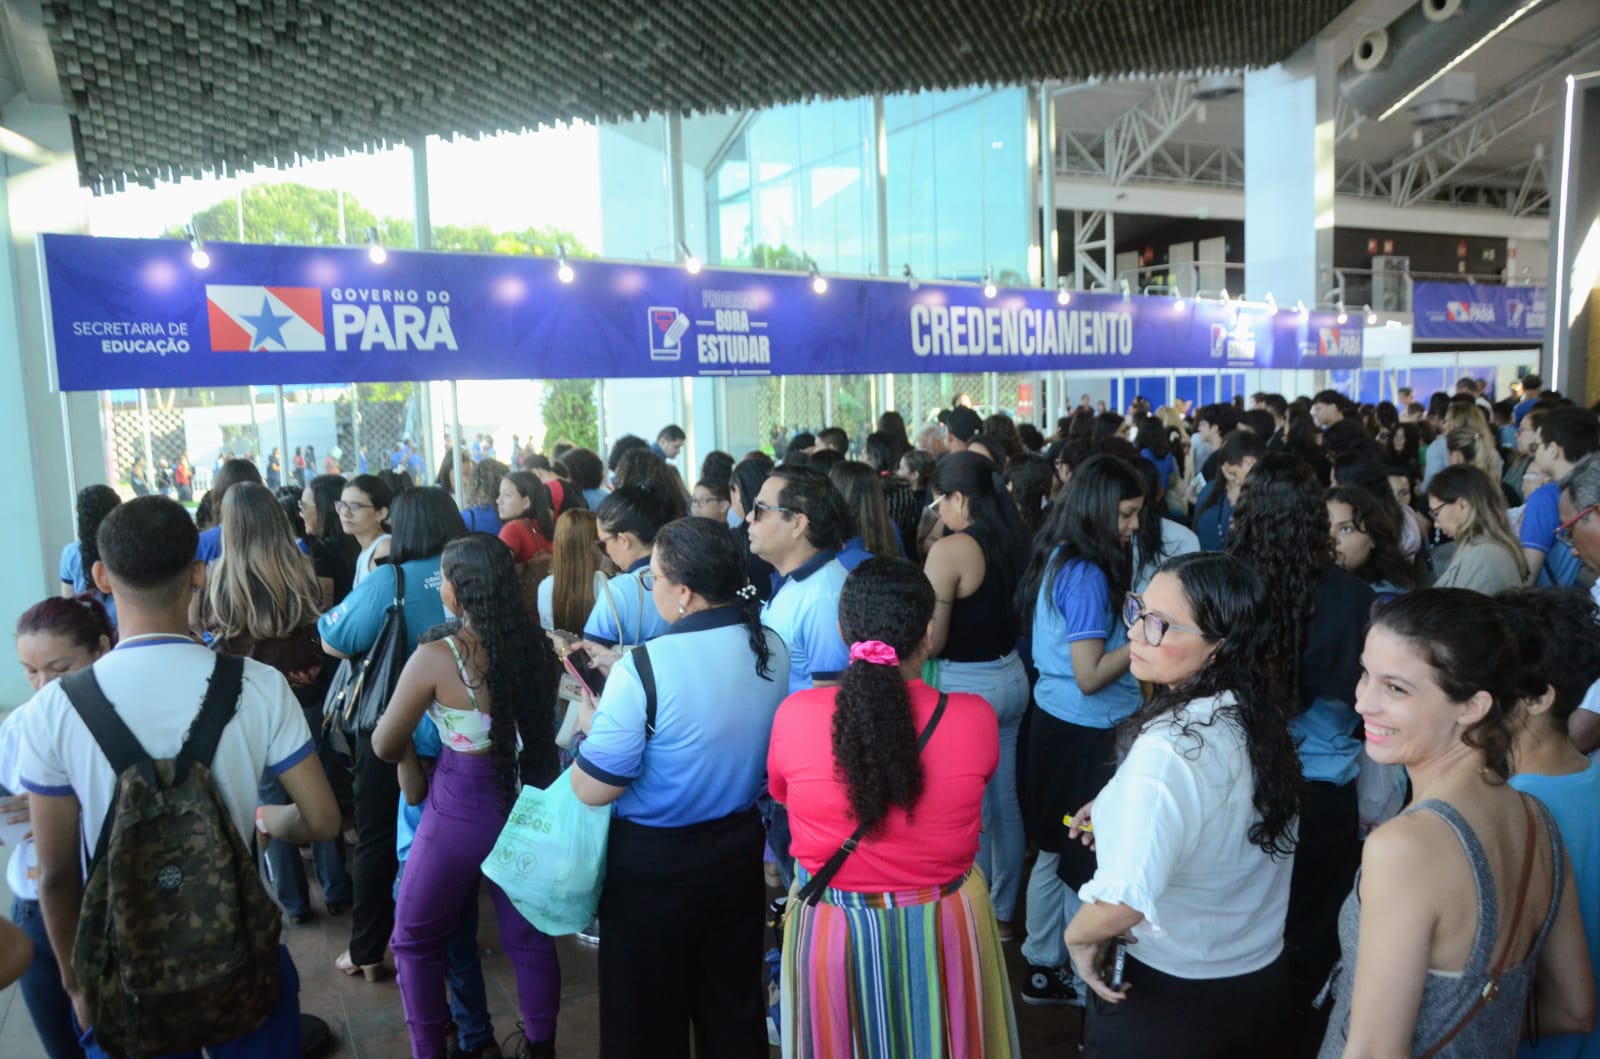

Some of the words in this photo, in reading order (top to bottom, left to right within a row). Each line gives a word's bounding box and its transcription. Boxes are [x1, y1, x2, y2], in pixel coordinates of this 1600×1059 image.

[331, 287, 418, 303] GOVERNO
[426, 290, 450, 304] DO
[72, 321, 165, 336] SECRETARIA
[168, 322, 188, 336] DE
[715, 309, 750, 333] BORA
[911, 303, 1133, 357] CREDENCIAMENTO
[101, 337, 190, 356] EDUCAÇÃO
[697, 333, 770, 364] ESTUDAR
